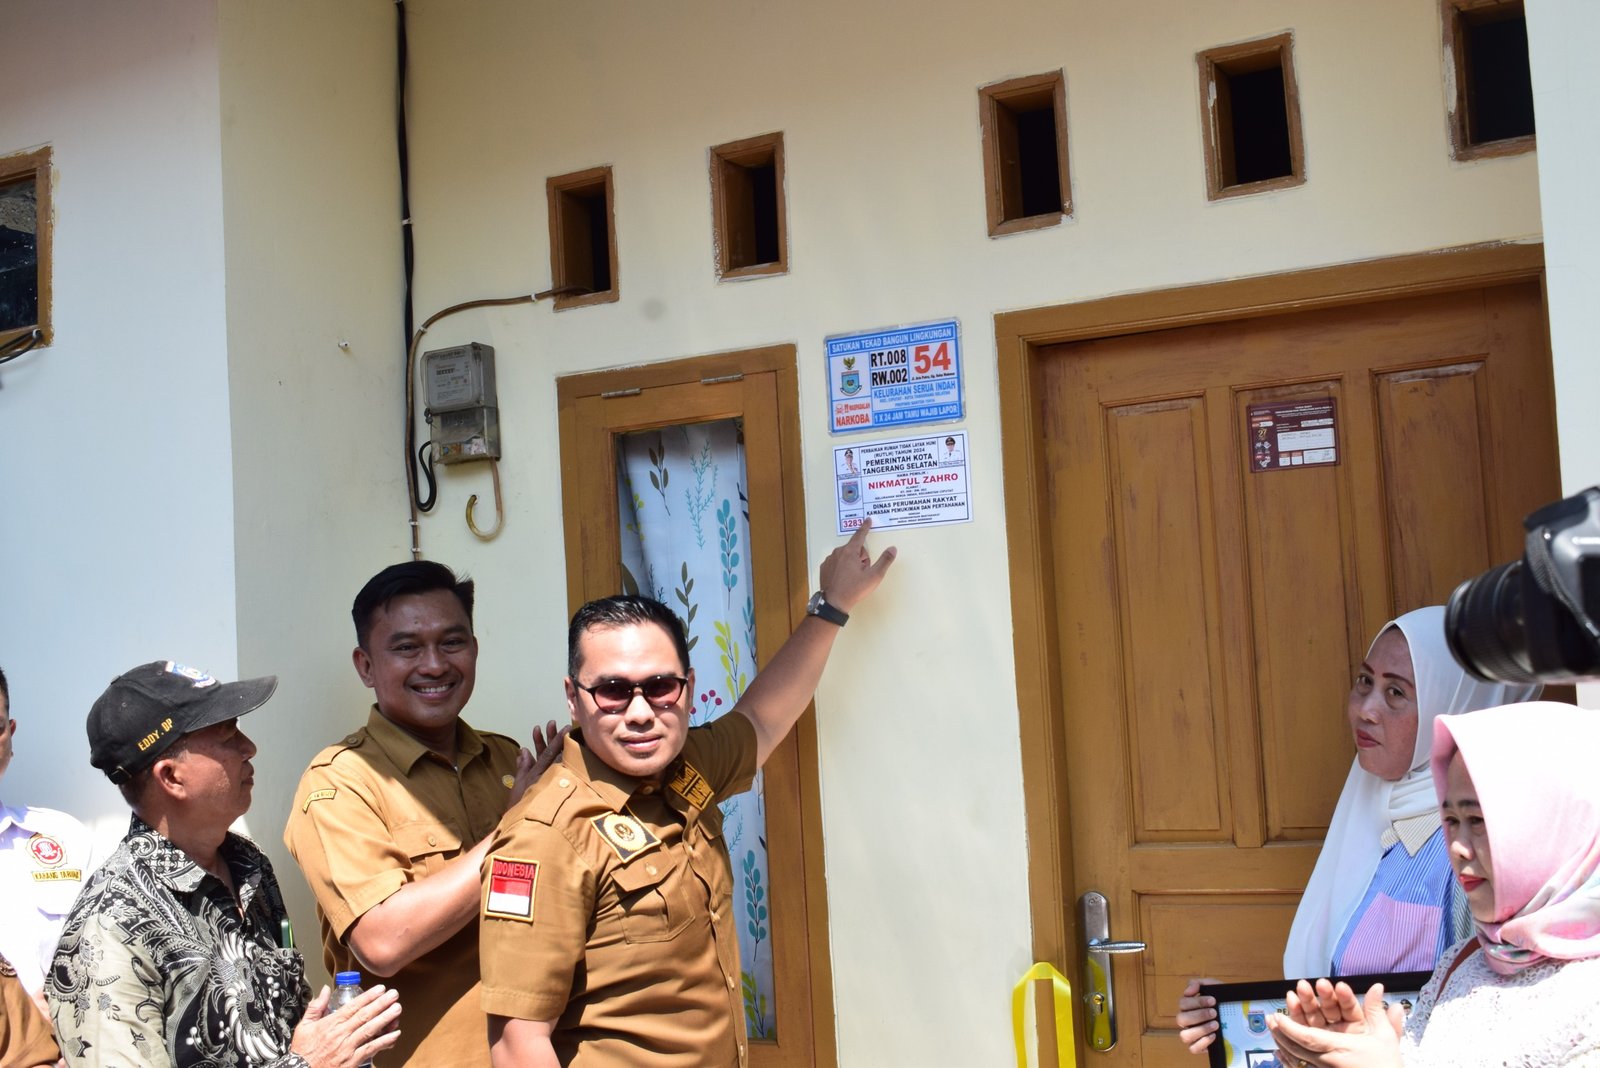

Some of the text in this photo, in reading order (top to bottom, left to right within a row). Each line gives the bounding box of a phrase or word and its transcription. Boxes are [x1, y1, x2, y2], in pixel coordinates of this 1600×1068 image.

[832, 328, 951, 353] SATUKAN TEKAD BANGUN LINGKUNGAN
[871, 349, 906, 368] RT.008
[914, 342, 951, 374] 54
[872, 368, 908, 386] RW.002
[874, 380, 956, 398] KELURAHAN SERUA INDAH
[836, 414, 870, 427] NARKOBA
[884, 414, 891, 422] 24
[892, 412, 903, 421] JAM
[904, 410, 919, 419] TAMU
[921, 408, 938, 418] WAJIB
[938, 405, 957, 415] LAPOR
[862, 464, 905, 475] TANGERANG
[906, 461, 938, 470] SELATAN
[866, 456, 911, 466] PEMERINTAH
[868, 473, 958, 490] NIKMATUL ZAHRO
[891, 505, 920, 514] PEMUKIMAN
[893, 498, 931, 507] PERUMAHAN
[843, 519, 862, 528] 3283
[493, 860, 534, 879] INDONESIA
